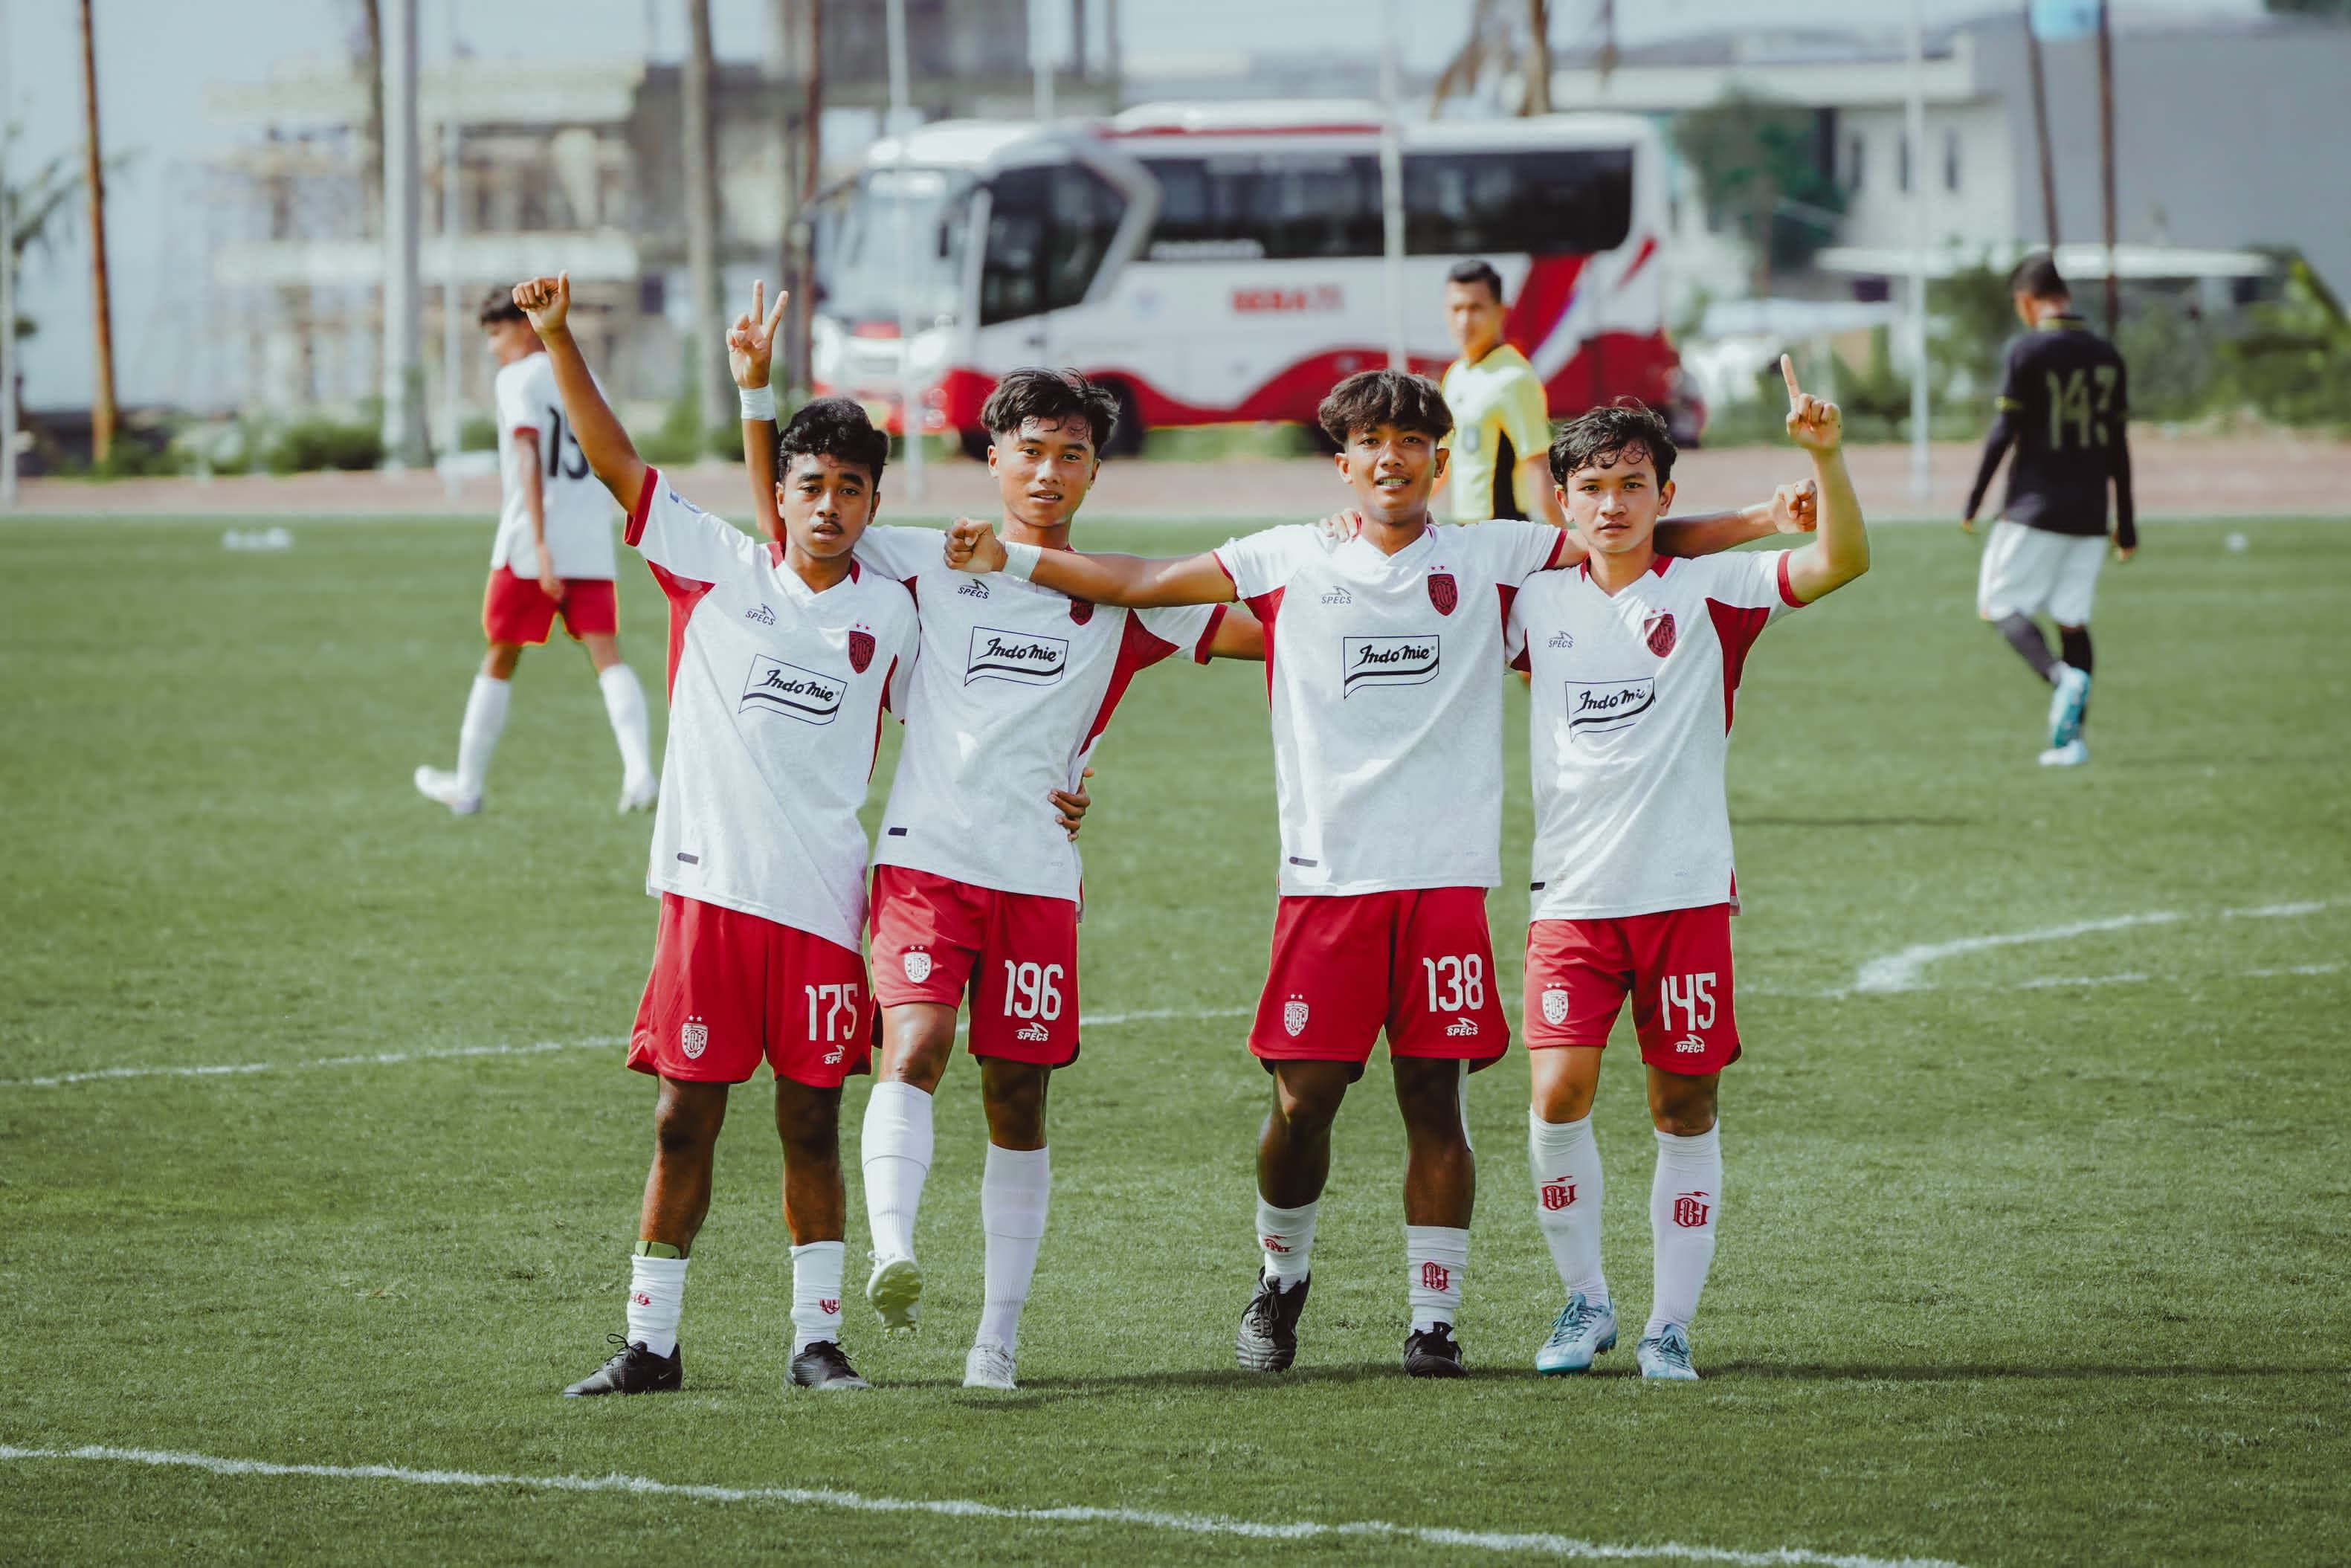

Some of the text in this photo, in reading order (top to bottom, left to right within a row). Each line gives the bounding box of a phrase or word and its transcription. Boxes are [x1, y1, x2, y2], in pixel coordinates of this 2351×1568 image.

[957, 587, 990, 600] SPECS
[1321, 596, 1352, 604] SPECS
[745, 610, 775, 626] SPECS
[1547, 639, 1575, 648] SPECS
[1422, 953, 1484, 1012] 138
[1004, 959, 1064, 1021] 196
[1661, 971, 1717, 1031] 145
[804, 983, 858, 1042] 175
[1016, 1030, 1049, 1042] SPECS
[1446, 1027, 1479, 1037] SPECS
[1675, 1043, 1706, 1054] SPECS
